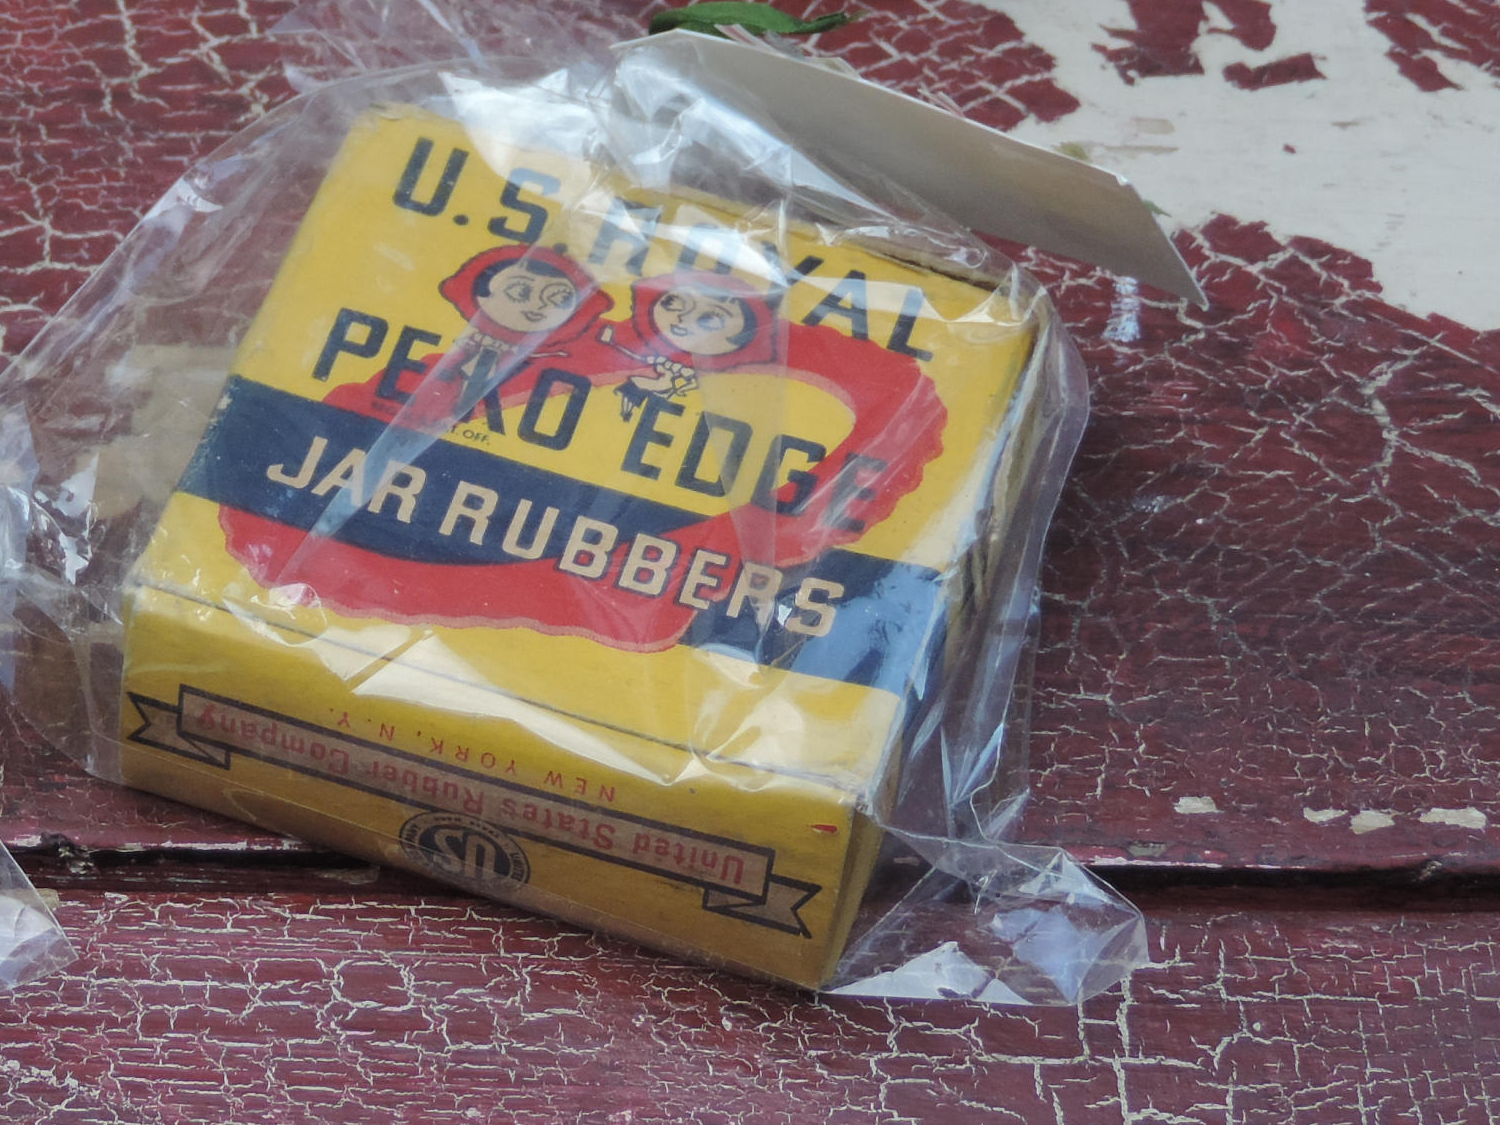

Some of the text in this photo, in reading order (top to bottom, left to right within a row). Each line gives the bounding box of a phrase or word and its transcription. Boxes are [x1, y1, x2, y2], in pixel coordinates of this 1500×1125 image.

[587, 195, 934, 362] ROYAL
[619, 394, 888, 535] EDGE
[266, 435, 845, 638] JAR RUBBERS
[197, 701, 350, 777] Company
[370, 759, 488, 816] Rubber
[543, 769, 617, 804] NEW
[500, 795, 616, 851] States
[632, 832, 746, 886] United
